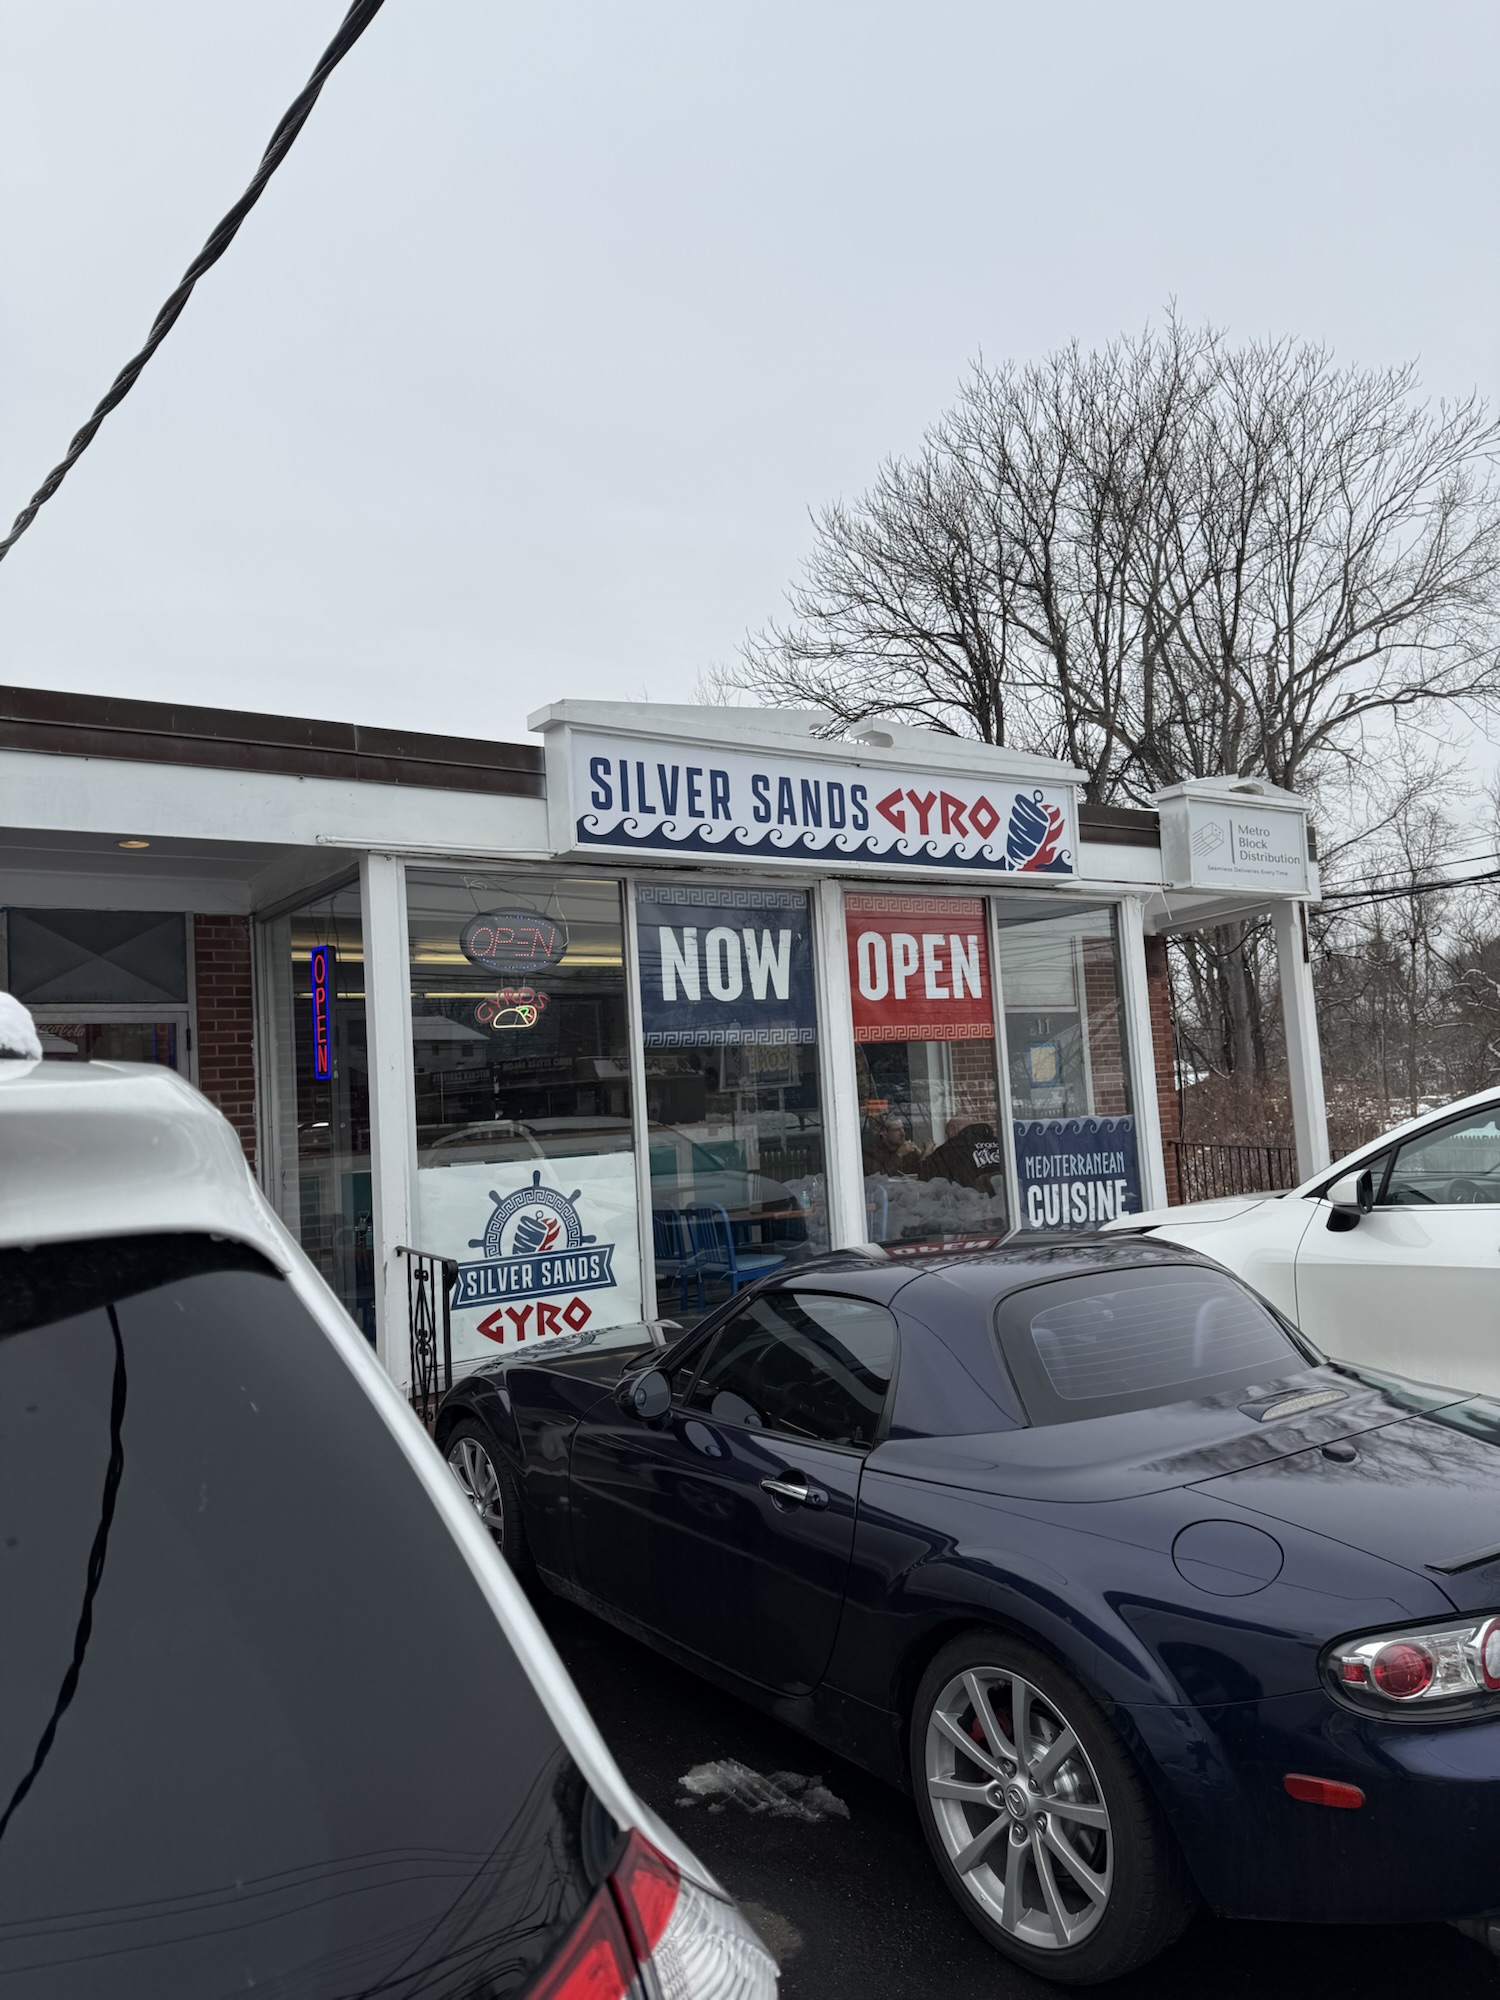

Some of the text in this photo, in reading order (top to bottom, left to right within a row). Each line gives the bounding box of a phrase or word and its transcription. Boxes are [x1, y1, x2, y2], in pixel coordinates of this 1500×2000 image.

[589, 756, 1001, 840] SILVER SANDS GYRO
[1237, 824, 1271, 838] Metro
[1238, 837, 1268, 850] Block
[1207, 865, 1288, 877] Seamless Deliveries Every Time
[1240, 850, 1301, 865] Distribution
[469, 927, 556, 957] OPEN
[658, 925, 792, 1002] NOW
[856, 930, 983, 1001] OPEN
[313, 954, 328, 1073] OPEN
[476, 988, 550, 1022] GYROS
[1025, 1151, 1125, 1180] MEDITERRANEAN
[1027, 1179, 1130, 1228] CUISINE
[466, 1254, 601, 1297] SILVER SANDS
[476, 1296, 593, 1344] GYRO
